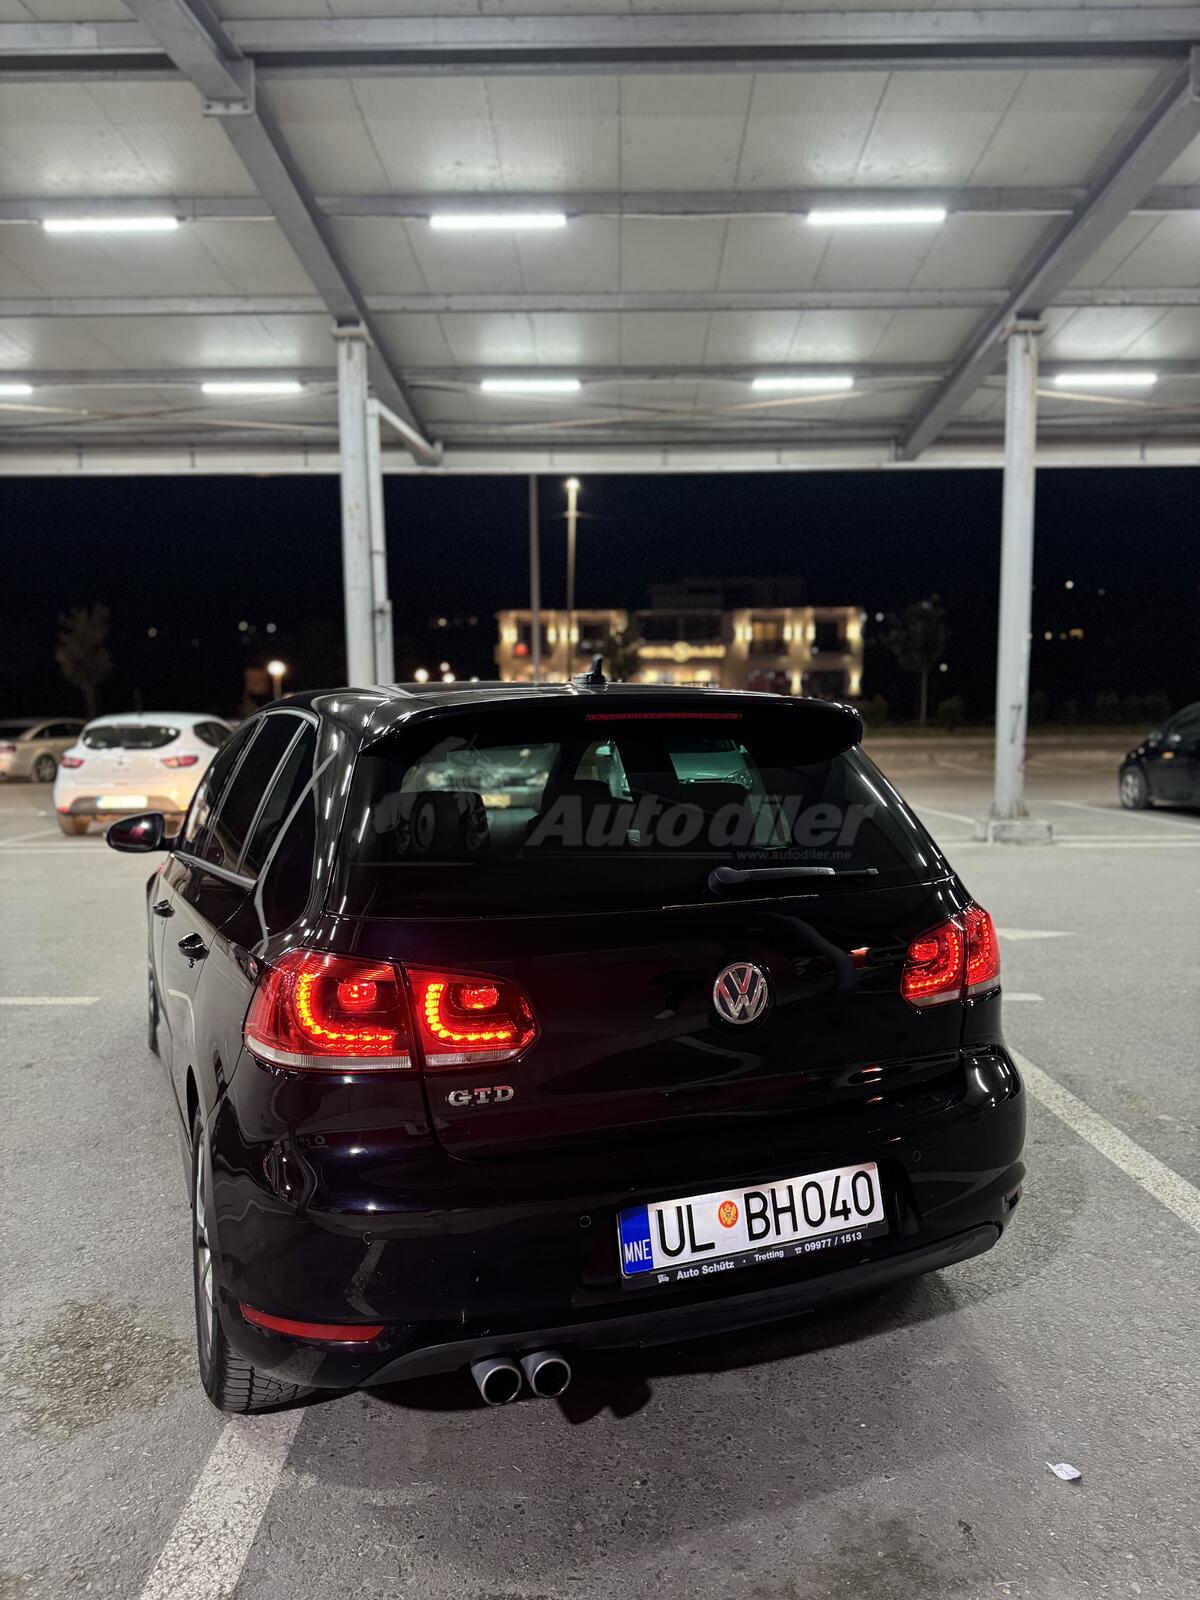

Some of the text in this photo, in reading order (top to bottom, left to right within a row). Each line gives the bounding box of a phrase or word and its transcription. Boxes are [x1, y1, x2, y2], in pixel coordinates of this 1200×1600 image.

[447, 1085, 515, 1107] GTD
[657, 1170, 875, 1257] UL BH040
[624, 1238, 652, 1264] MNE
[676, 1268, 700, 1281] Auto
[701, 1260, 735, 1275] Schütz
[754, 1249, 785, 1263] Tretting
[804, 1239, 832, 1252] 09977
[840, 1231, 862, 1244] 1513
